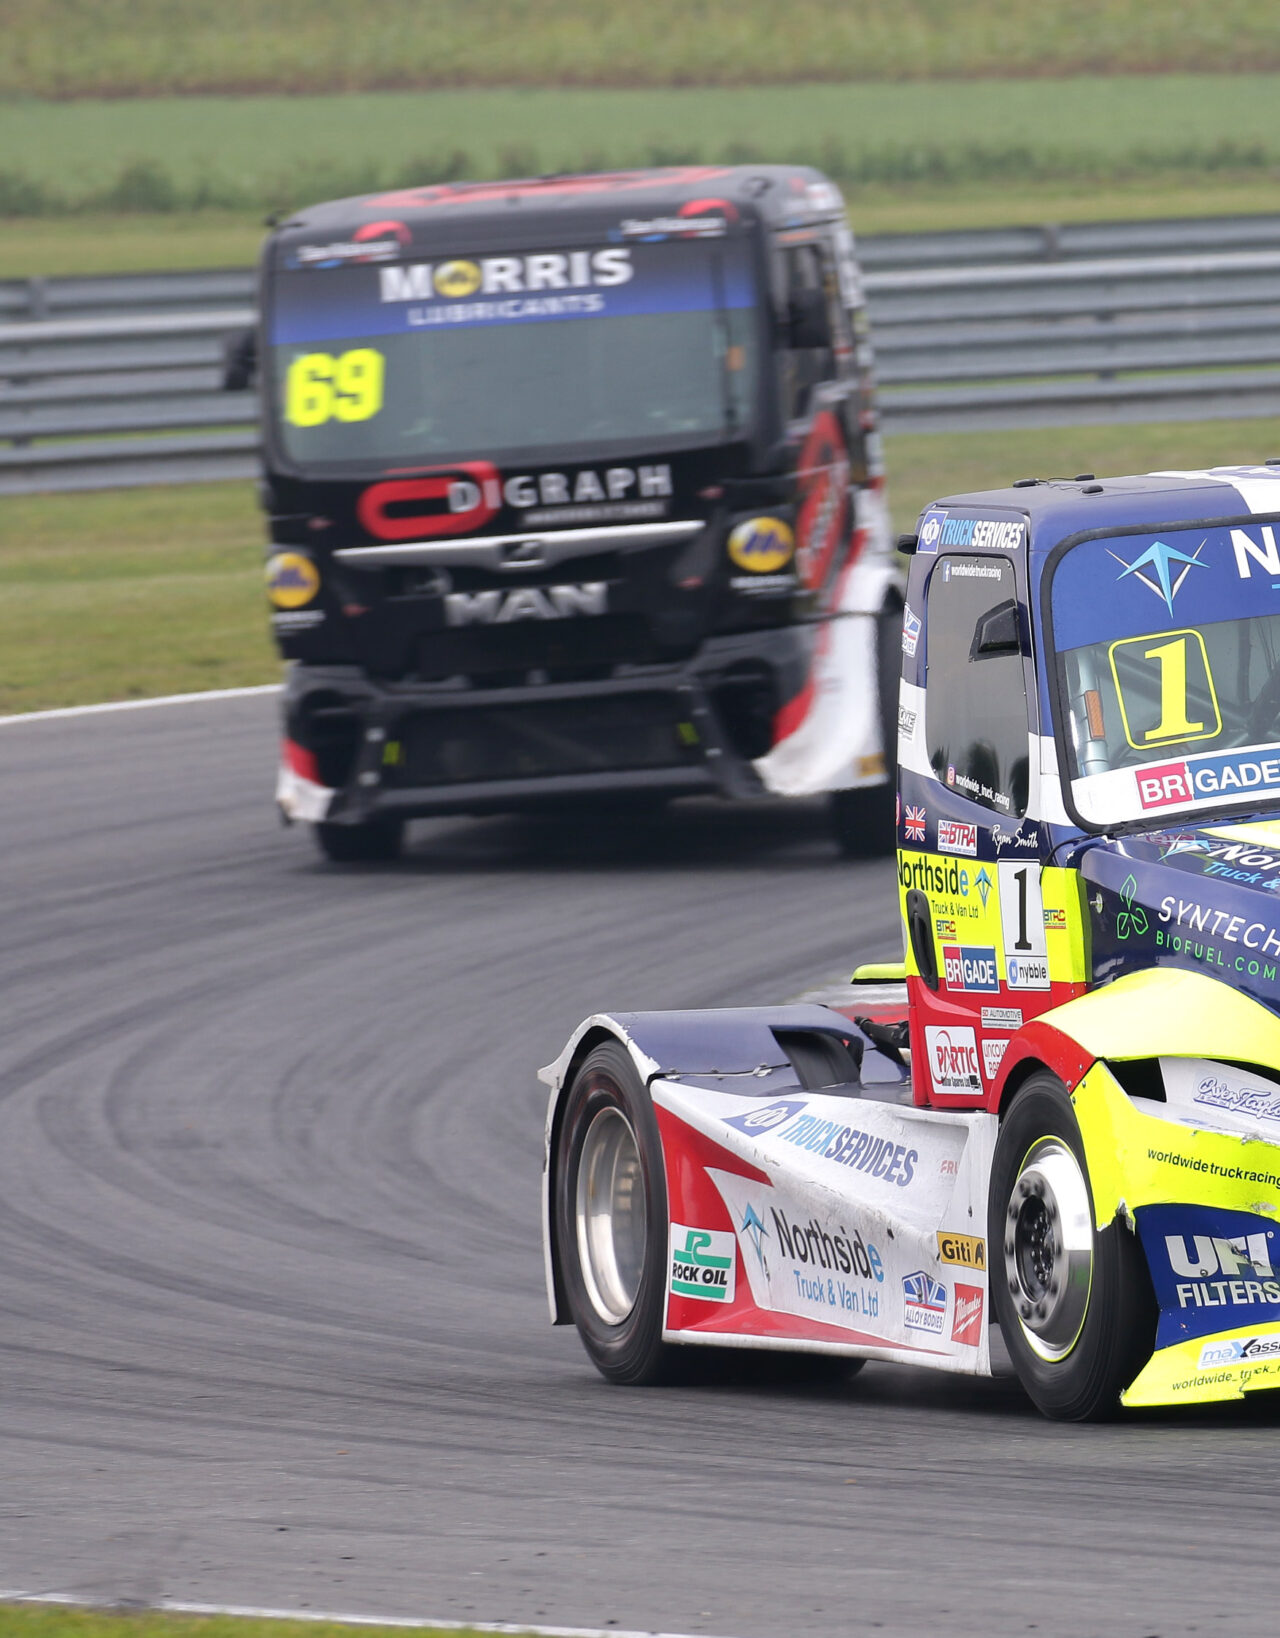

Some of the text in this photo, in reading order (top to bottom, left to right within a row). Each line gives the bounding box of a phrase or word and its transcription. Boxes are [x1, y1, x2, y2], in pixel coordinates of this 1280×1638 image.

[379, 248, 634, 303] MORRIS
[407, 293, 604, 326] LUBRICANTS
[285, 348, 386, 428] 69
[447, 464, 674, 514] DIGRAPH
[941, 519, 1025, 550] TRUCKSERVICES
[444, 581, 609, 627] MAN
[1144, 637, 1204, 741] 1
[948, 823, 977, 849] BTRA
[1014, 827, 1039, 849] Smith
[1203, 861, 1264, 884] Truck
[931, 900, 979, 919] Truck & Van Ltd
[1014, 867, 1033, 951] 1
[945, 957, 996, 985] BRIGADE
[1019, 963, 1047, 984] nybble
[1155, 929, 1277, 982] BIOFUEL.COM
[777, 1114, 918, 1187] TRUCKSERVICES
[769, 1206, 884, 1283] Northside
[941, 1239, 971, 1263] Giti
[1164, 1232, 1274, 1278] UFI
[672, 1262, 728, 1286] ROCK OIL
[793, 1270, 879, 1317] Truck & Van Ltd
[923, 1311, 943, 1328] BODIES
